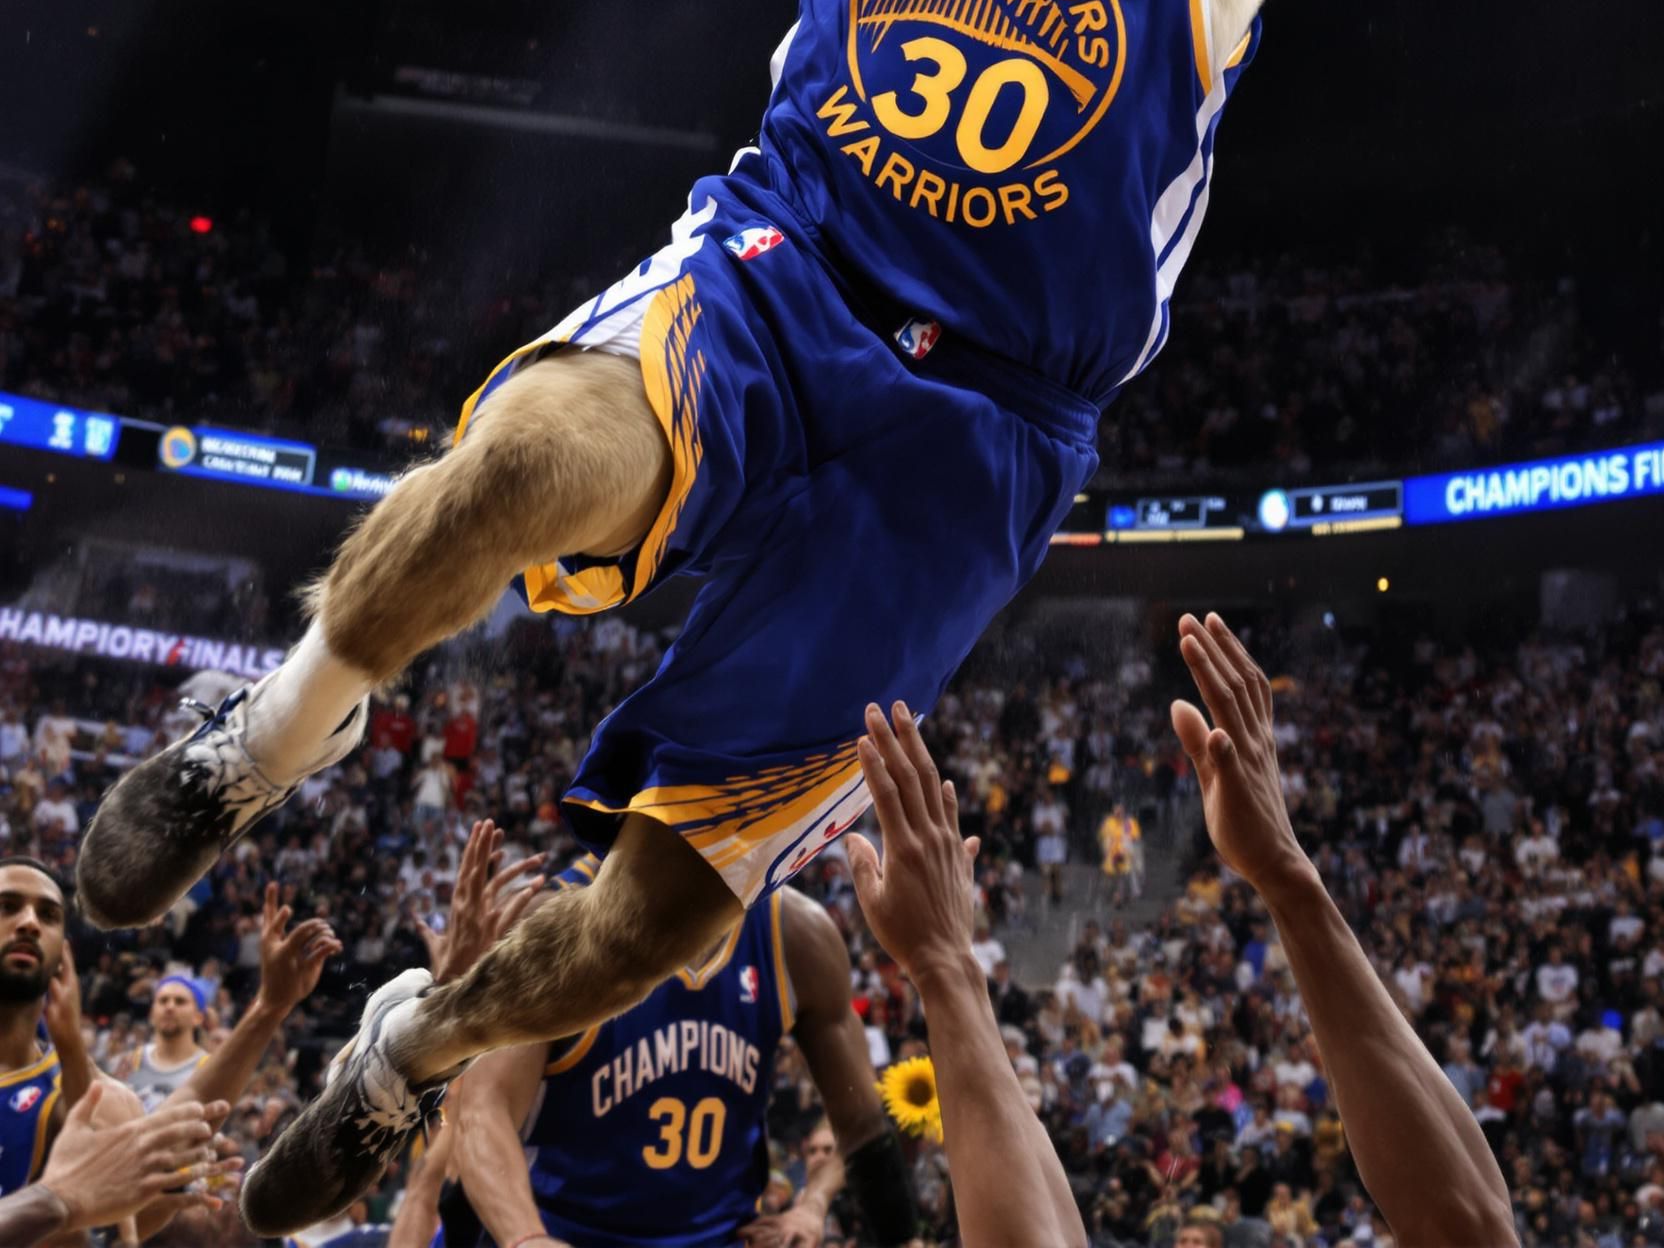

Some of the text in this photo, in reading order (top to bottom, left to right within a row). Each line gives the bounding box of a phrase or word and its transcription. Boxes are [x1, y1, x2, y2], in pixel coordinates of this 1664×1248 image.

[872, 36, 1049, 174] 30
[816, 85, 1070, 229] WARRIORS
[1445, 449, 1664, 516] CHAMPIONS FI
[591, 1019, 760, 1118] CHAMPIONS
[642, 1097, 726, 1169] 30
